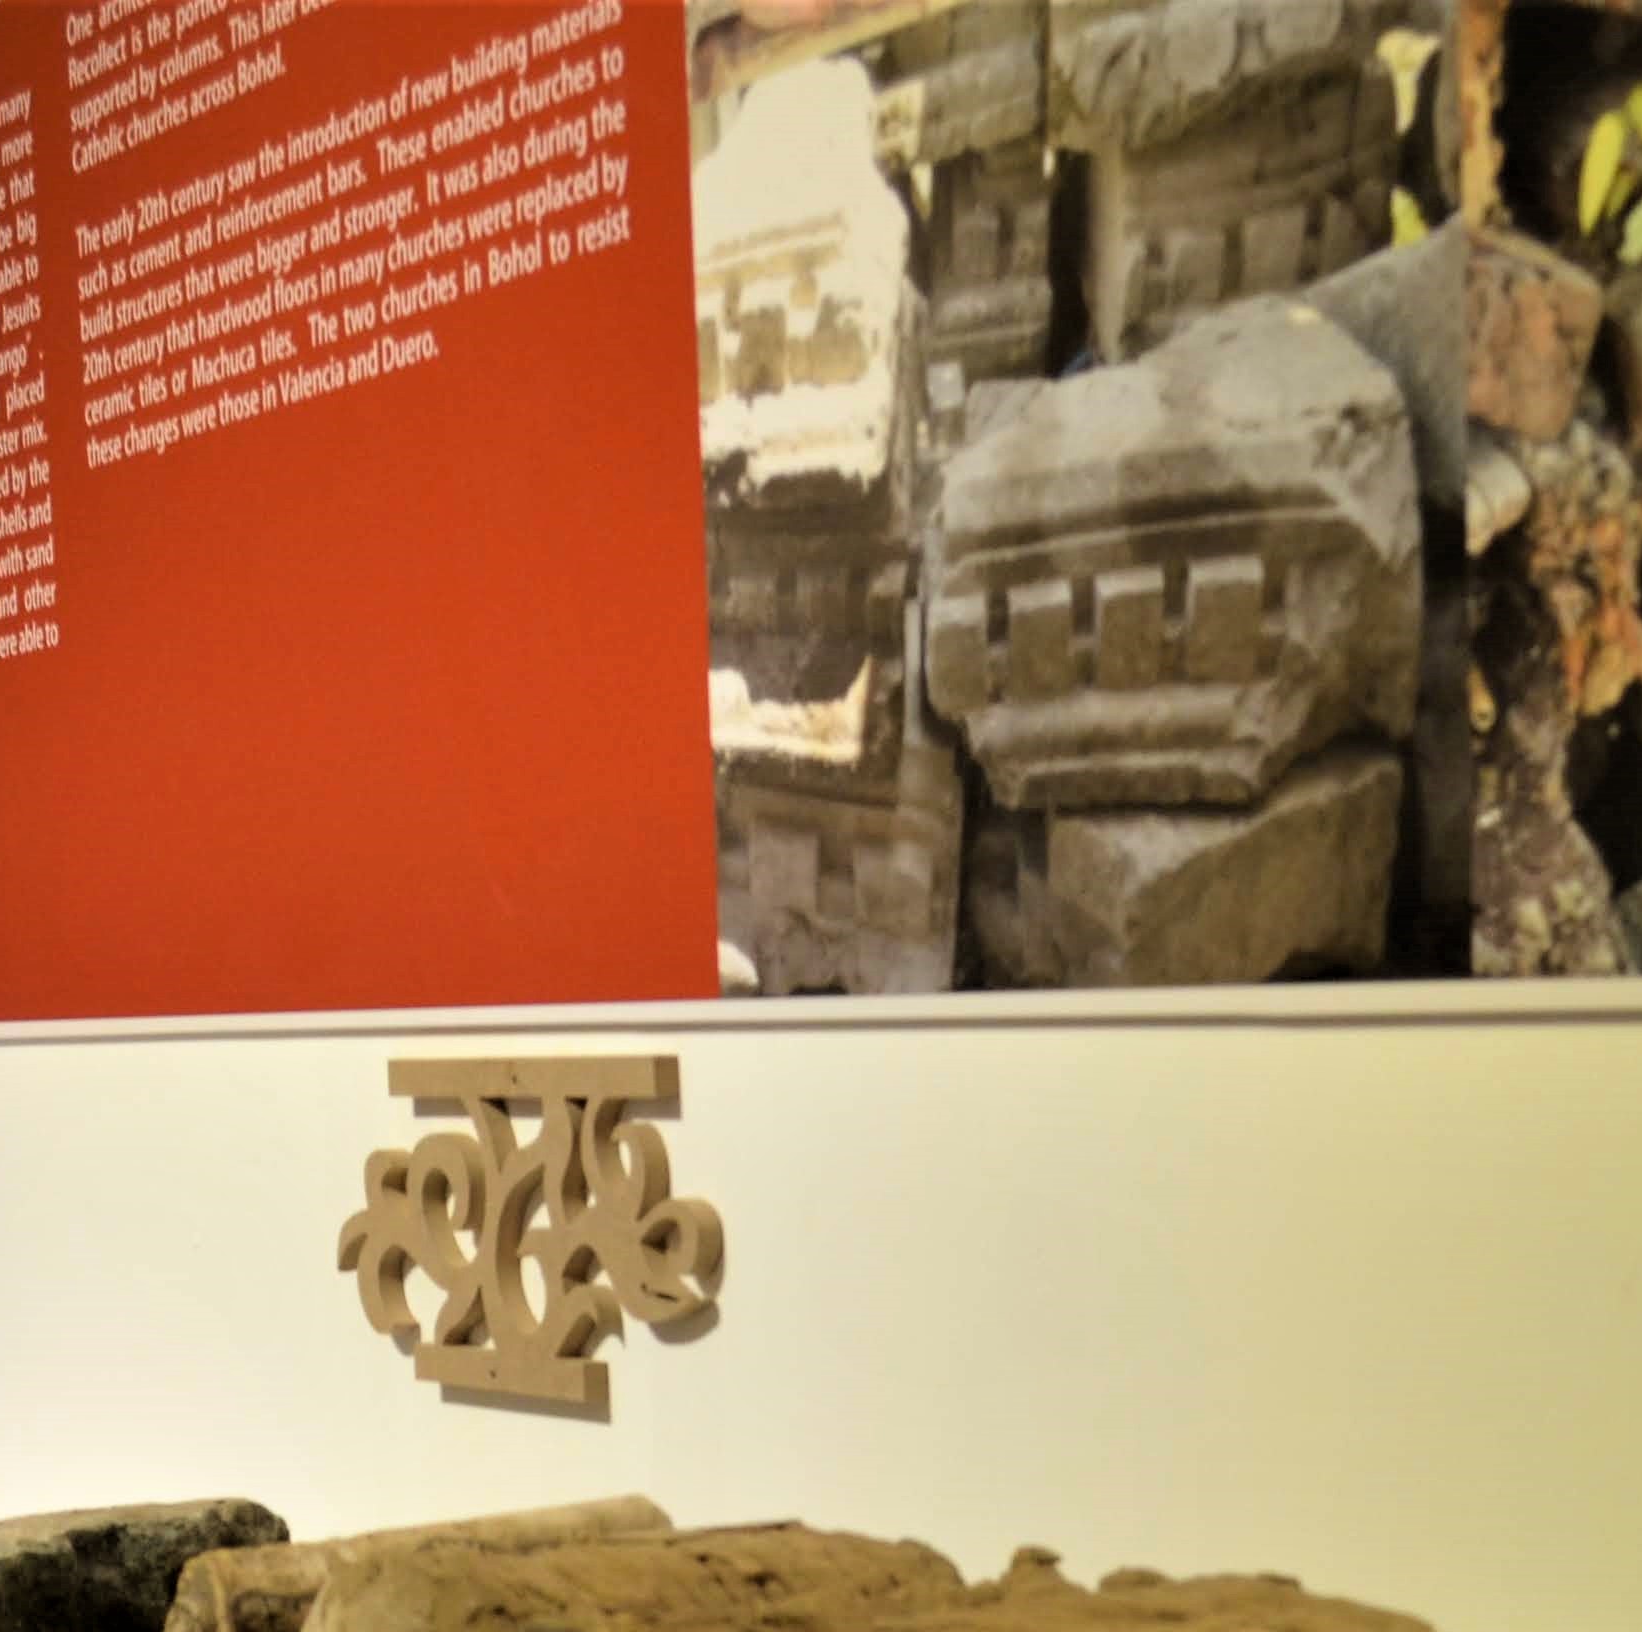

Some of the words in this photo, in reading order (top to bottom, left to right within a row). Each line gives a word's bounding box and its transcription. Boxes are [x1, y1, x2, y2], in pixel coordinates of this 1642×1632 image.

[66, 11, 93, 46] One
[68, 35, 127, 88] Recollect
[131, 26, 143, 55] is
[147, 13, 171, 47] the
[70, 68, 138, 132] supported
[139, 64, 157, 100] by
[159, 35, 223, 86] columns.
[230, 10, 260, 50] This
[261, 0, 298, 35] later
[72, 124, 124, 173] Catholic
[126, 96, 188, 147] churches
[190, 74, 235, 116] across
[237, 42, 285, 94] Bohol.
[1, 130, 33, 166] more
[75, 224, 100, 258] The
[102, 208, 134, 247] early
[137, 191, 168, 232] 20th
[170, 171, 224, 217] century
[227, 158, 256, 192] saw
[259, 142, 285, 178] the
[288, 99, 387, 165] introduction
[390, 78, 407, 120] of
[411, 72, 448, 109] new
[451, 35, 528, 93] building
[531, 0, 623, 59] materials
[9, 170, 35, 204] that
[78, 261, 108, 300] such
[112, 259, 126, 286] as
[129, 233, 181, 278] cement
[185, 214, 212, 256] and
[216, 172, 323, 242] reinforcement
[327, 159, 367, 196] bars.
[378, 131, 427, 174] These
[431, 88, 504, 152] enabled
[509, 59, 596, 120] churches
[601, 46, 624, 82] to
[16, 211, 37, 245] big
[80, 300, 113, 342] build
[116, 280, 183, 329] structures
[185, 265, 215, 301] that
[217, 252, 254, 287] were
[256, 231, 306, 278] bigger
[310, 208, 341, 252] and
[344, 187, 418, 239] stronger.
[427, 171, 440, 205] It
[443, 162, 479, 197] was
[482, 143, 520, 184] also
[523, 116, 588, 168] during
[591, 98, 626, 140] the
[25, 255, 39, 281] to
[83, 346, 112, 385] 20th
[114, 333, 164, 373] century
[166, 318, 195, 353] that
[197, 283, 272, 341] hardwood
[274, 274, 318, 313] floors
[321, 264, 336, 296] in
[339, 250, 385, 288] many
[387, 218, 465, 272] churches
[467, 200, 512, 240] were
[516, 156, 598, 225] replaced
[601, 152, 628, 196] by
[2, 294, 41, 334] Jesuits
[84, 384, 134, 426] ceramic
[139, 374, 167, 407] tiles
[172, 369, 186, 395] or
[192, 344, 256, 388] Machuca
[260, 328, 297, 365] tiles.
[308, 311, 338, 347] The
[343, 301, 376, 336] two
[381, 271, 458, 323] churches
[464, 260, 481, 293] in
[488, 231, 542, 285] Bohol
[548, 231, 570, 264] to
[577, 205, 630, 254] resist
[5, 371, 45, 420] placed
[86, 435, 122, 468] these
[124, 416, 180, 457] changes
[181, 404, 216, 436] were
[218, 389, 260, 425] those
[262, 380, 277, 411] in
[280, 356, 345, 404] Valencia
[348, 340, 379, 384] and
[381, 330, 439, 373] Duero.
[21, 417, 47, 448] mix.
[11, 464, 27, 497] by
[29, 457, 49, 488] the
[29, 493, 52, 529] and
[25, 534, 54, 571] sand
[24, 579, 56, 612] other
[19, 621, 44, 654] able
[45, 623, 59, 647] to
